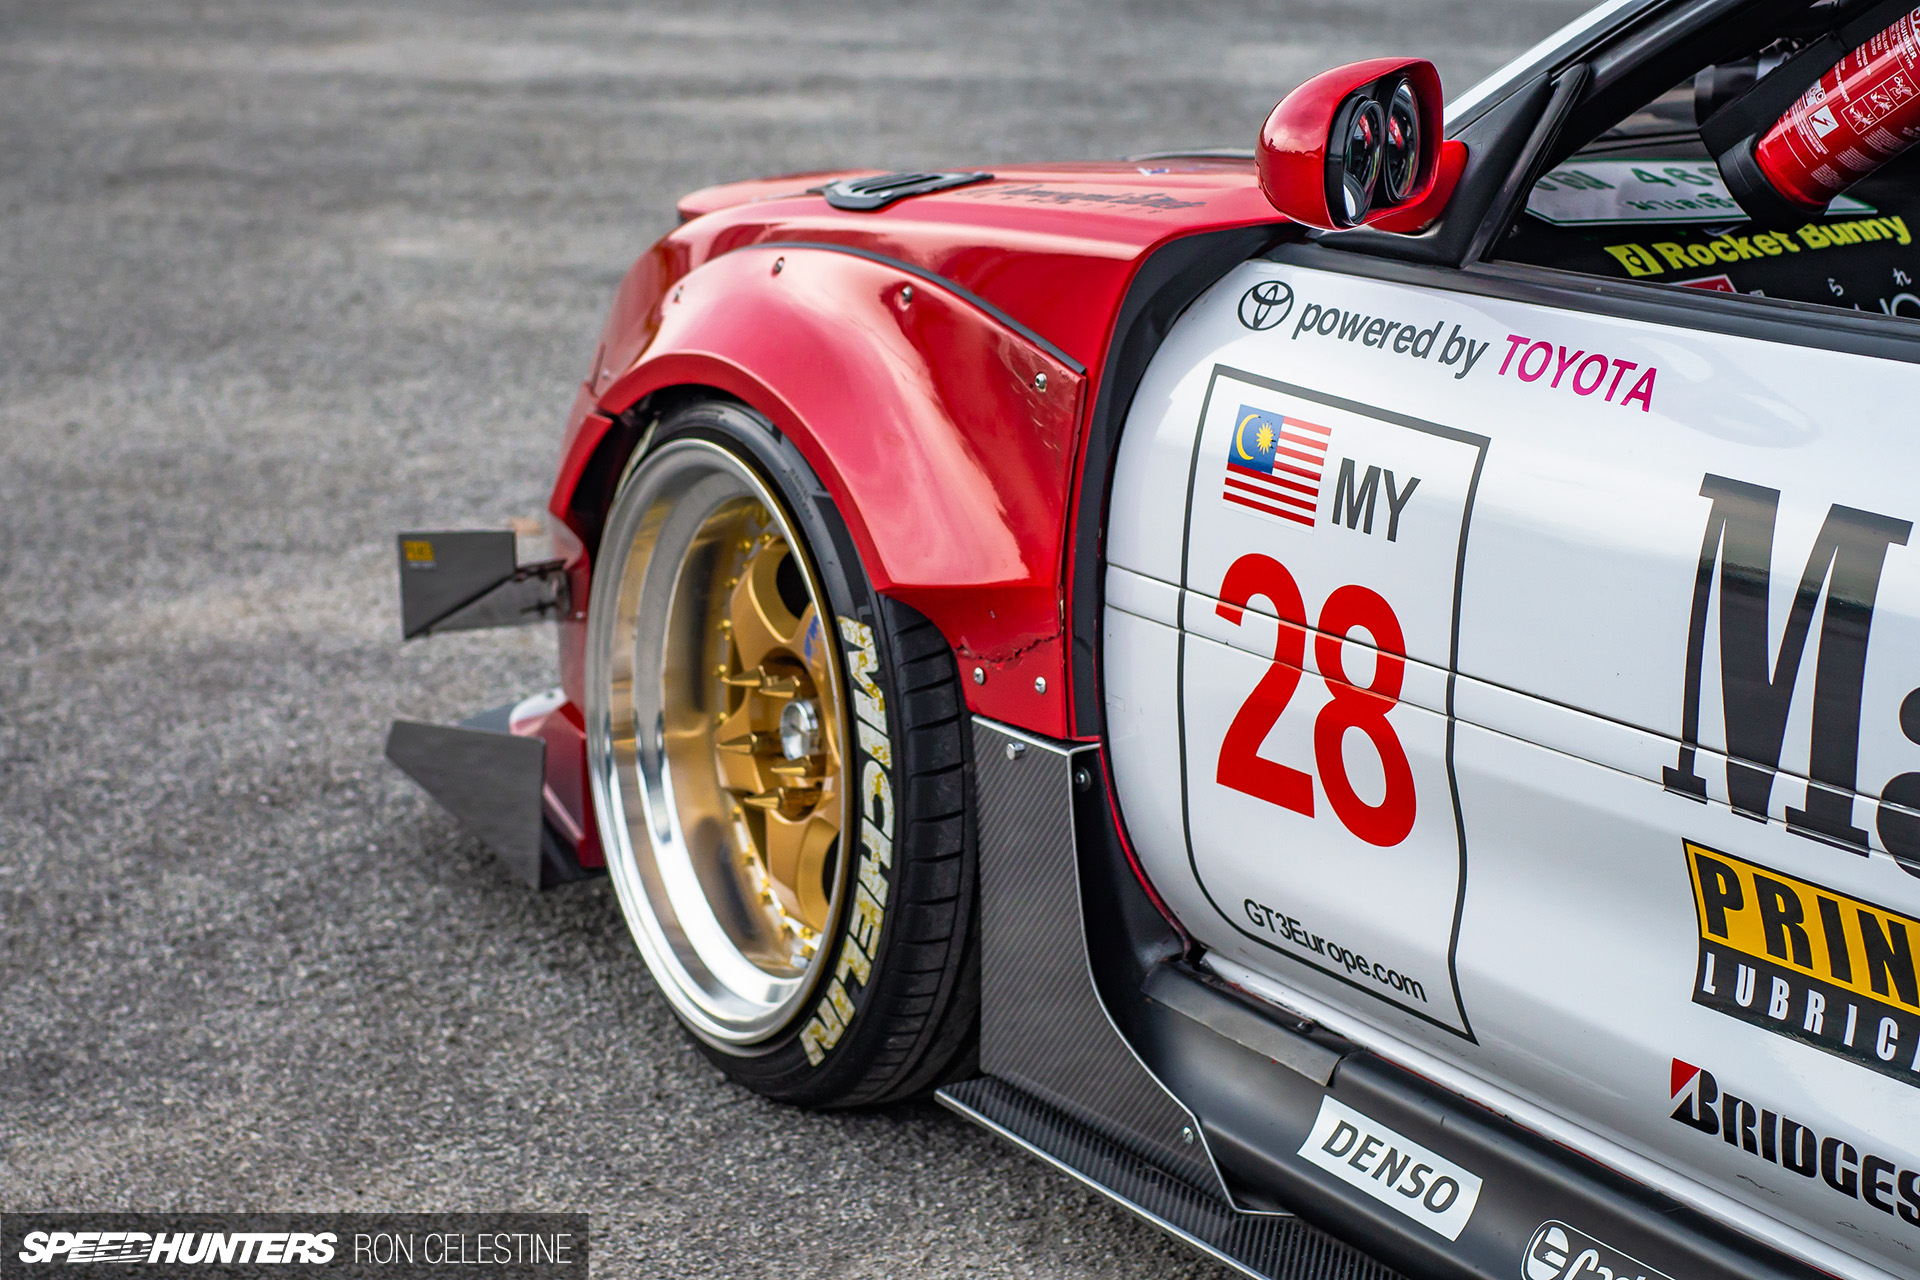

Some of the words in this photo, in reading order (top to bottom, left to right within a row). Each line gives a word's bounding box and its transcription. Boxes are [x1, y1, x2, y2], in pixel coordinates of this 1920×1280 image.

[1652, 230, 1801, 269] Rocket
[1796, 216, 1912, 249] Bunny
[1293, 298, 1443, 359] powered
[1438, 323, 1490, 379] by
[1497, 333, 1658, 413] TOYOTA
[1332, 457, 1421, 542] MY
[1215, 553, 1417, 847] 28
[800, 615, 896, 1067] MICHELIN
[1243, 898, 1428, 1004] GT3Europe.com
[1321, 1120, 1460, 1213] DENSO
